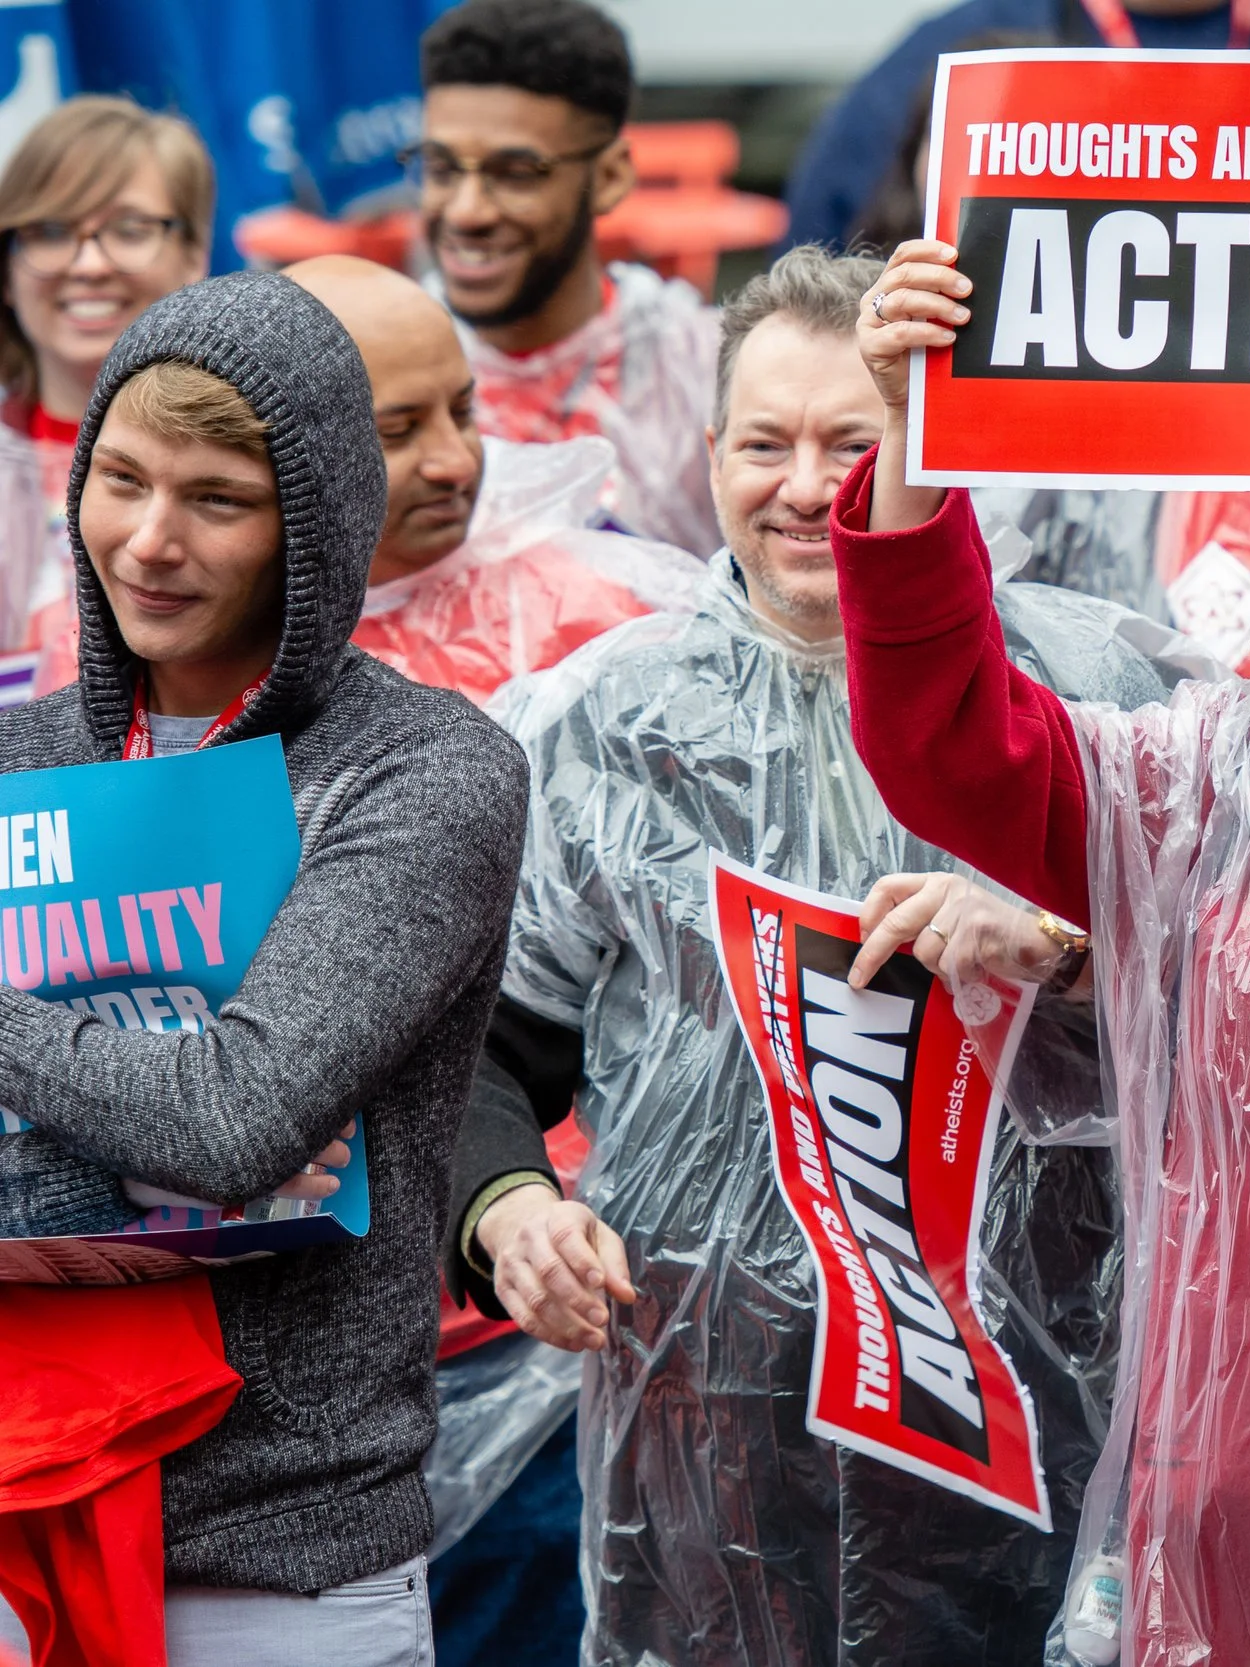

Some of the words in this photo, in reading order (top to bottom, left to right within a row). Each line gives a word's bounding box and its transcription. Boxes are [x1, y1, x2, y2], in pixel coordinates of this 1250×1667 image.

[966, 122, 1197, 180] THOUGHTS
[129, 732, 142, 760] ATHEIS
[139, 730, 150, 759] AMERIC
[0, 883, 225, 991] UALITY
[52, 986, 217, 1037] DER
[941, 1038, 980, 1164] atheists.org
[790, 1104, 831, 1198] AND
[802, 967, 984, 1430] ACTION
[813, 1200, 891, 1413] THOUGHTS
